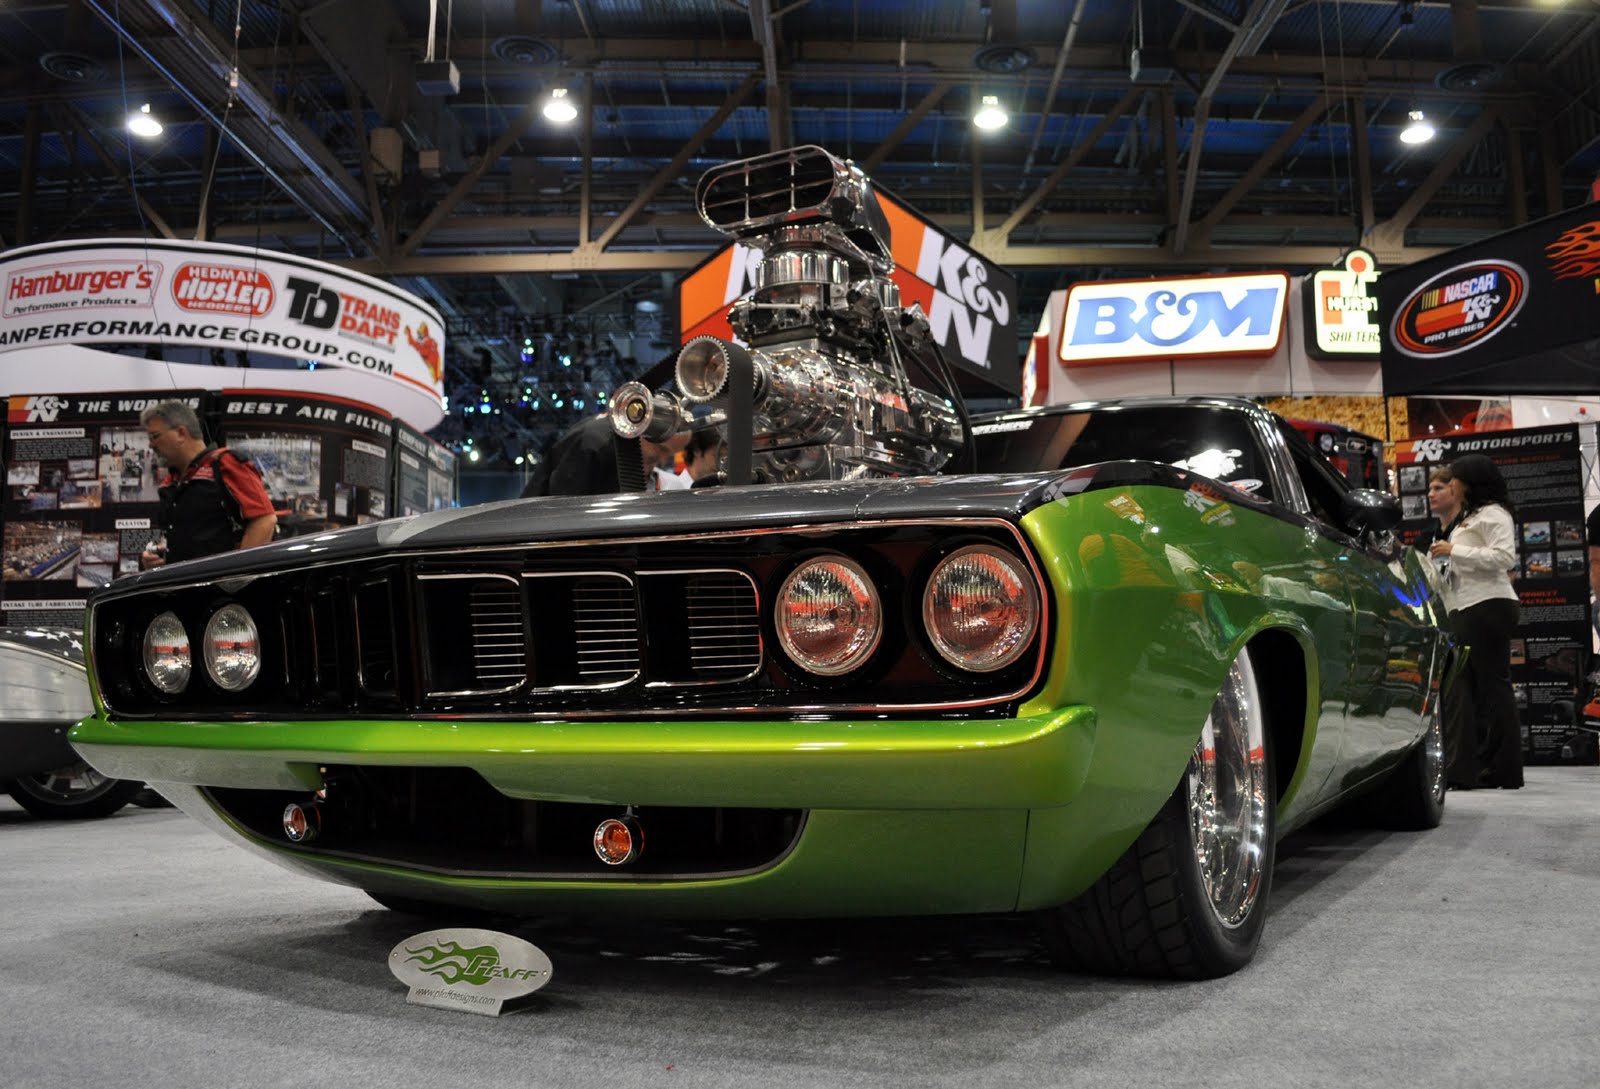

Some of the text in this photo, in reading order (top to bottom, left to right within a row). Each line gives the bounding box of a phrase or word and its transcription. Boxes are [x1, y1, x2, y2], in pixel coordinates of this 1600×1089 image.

[9, 264, 152, 300] Hamburger's
[189, 266, 259, 284] HEDMAN
[1444, 272, 1496, 304] NASCAR
[13, 297, 137, 314] Performance Products
[338, 292, 400, 329] TRANS
[915, 226, 1009, 369] K&N
[1461, 293, 1500, 324] K&N
[340, 314, 398, 345] DAPT
[1069, 287, 1279, 347] B&M
[1424, 321, 1485, 344] PRO SERIES
[24, 396, 69, 422] K&N
[78, 401, 111, 413] THE
[226, 401, 392, 437] BEST AIR FILTER
[1411, 432, 1573, 462] K&N MOTORSPORTS
[463, 955, 539, 980] PFAFF
[415, 987, 496, 1006] www.pfaffdesigns.com
